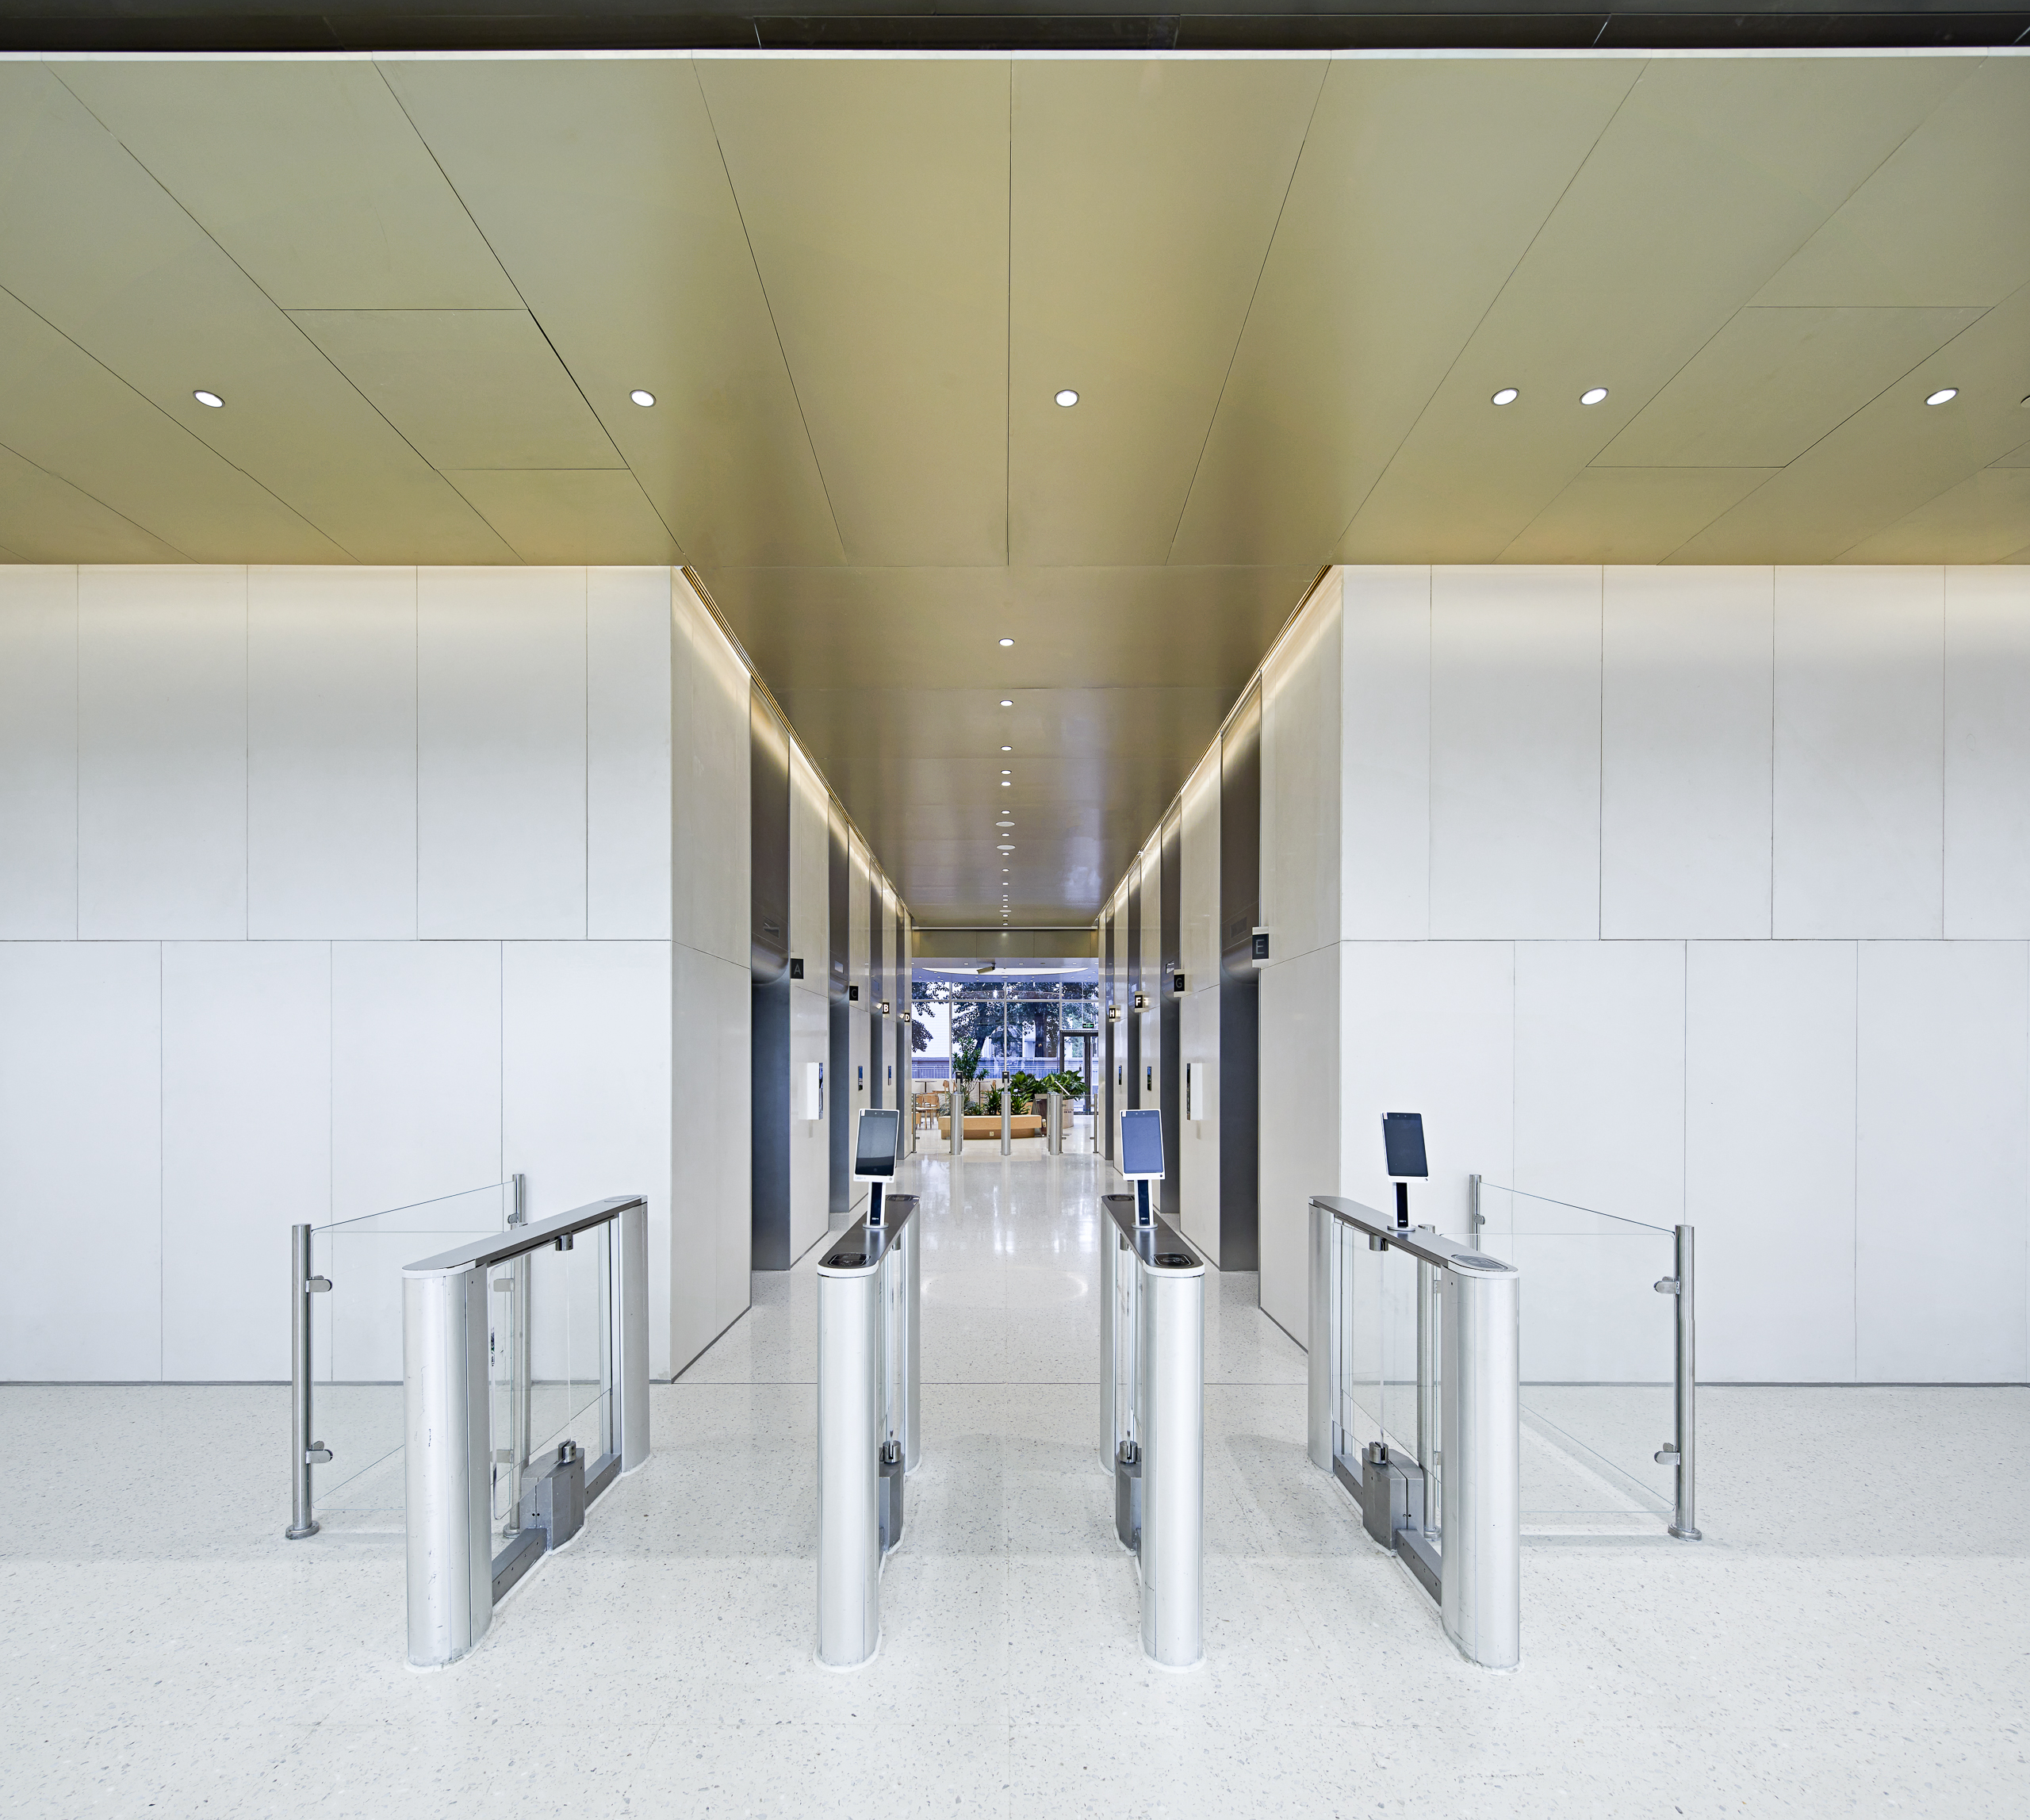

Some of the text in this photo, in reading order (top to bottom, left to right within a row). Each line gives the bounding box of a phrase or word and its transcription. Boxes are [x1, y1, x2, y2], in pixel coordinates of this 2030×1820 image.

[1256, 939, 1264, 954] E
[794, 964, 802, 975] A
[1175, 978, 1182, 988] G
[851, 989, 857, 998] C
[1136, 997, 1142, 1006] F
[883, 1004, 889, 1013] B
